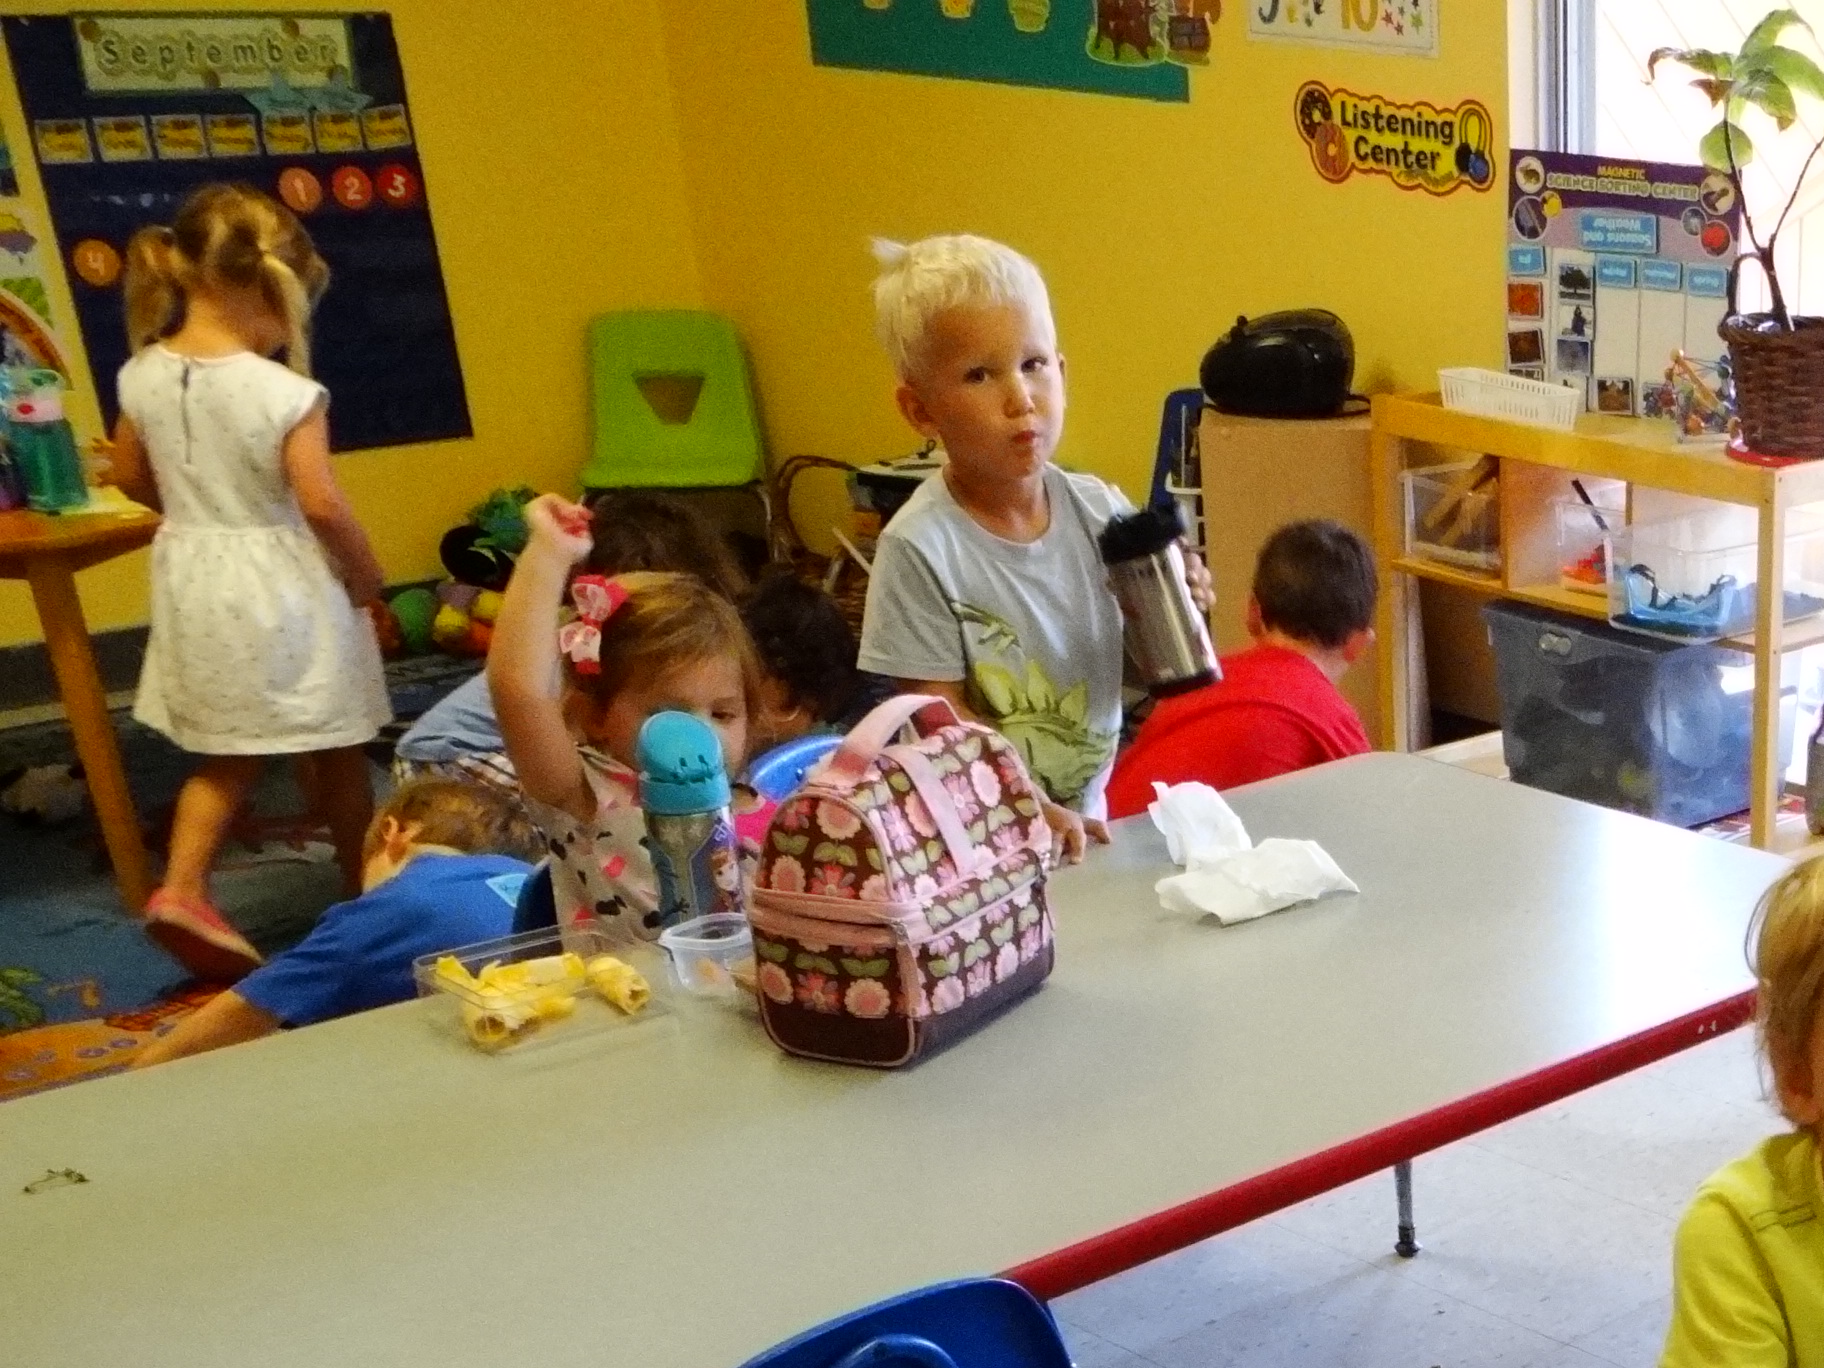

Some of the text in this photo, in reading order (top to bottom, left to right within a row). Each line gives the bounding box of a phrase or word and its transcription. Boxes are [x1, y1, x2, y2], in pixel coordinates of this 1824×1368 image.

[102, 37, 331, 71] September
[1339, 100, 1456, 146] Listening
[1353, 135, 1441, 171] Center
[1547, 173, 1700, 201] SCIENCE SORTING CENTER
[1598, 165, 1646, 180] MAGNETIC
[293, 173, 406, 203] 1 2 3
[86, 250, 106, 276] 4
